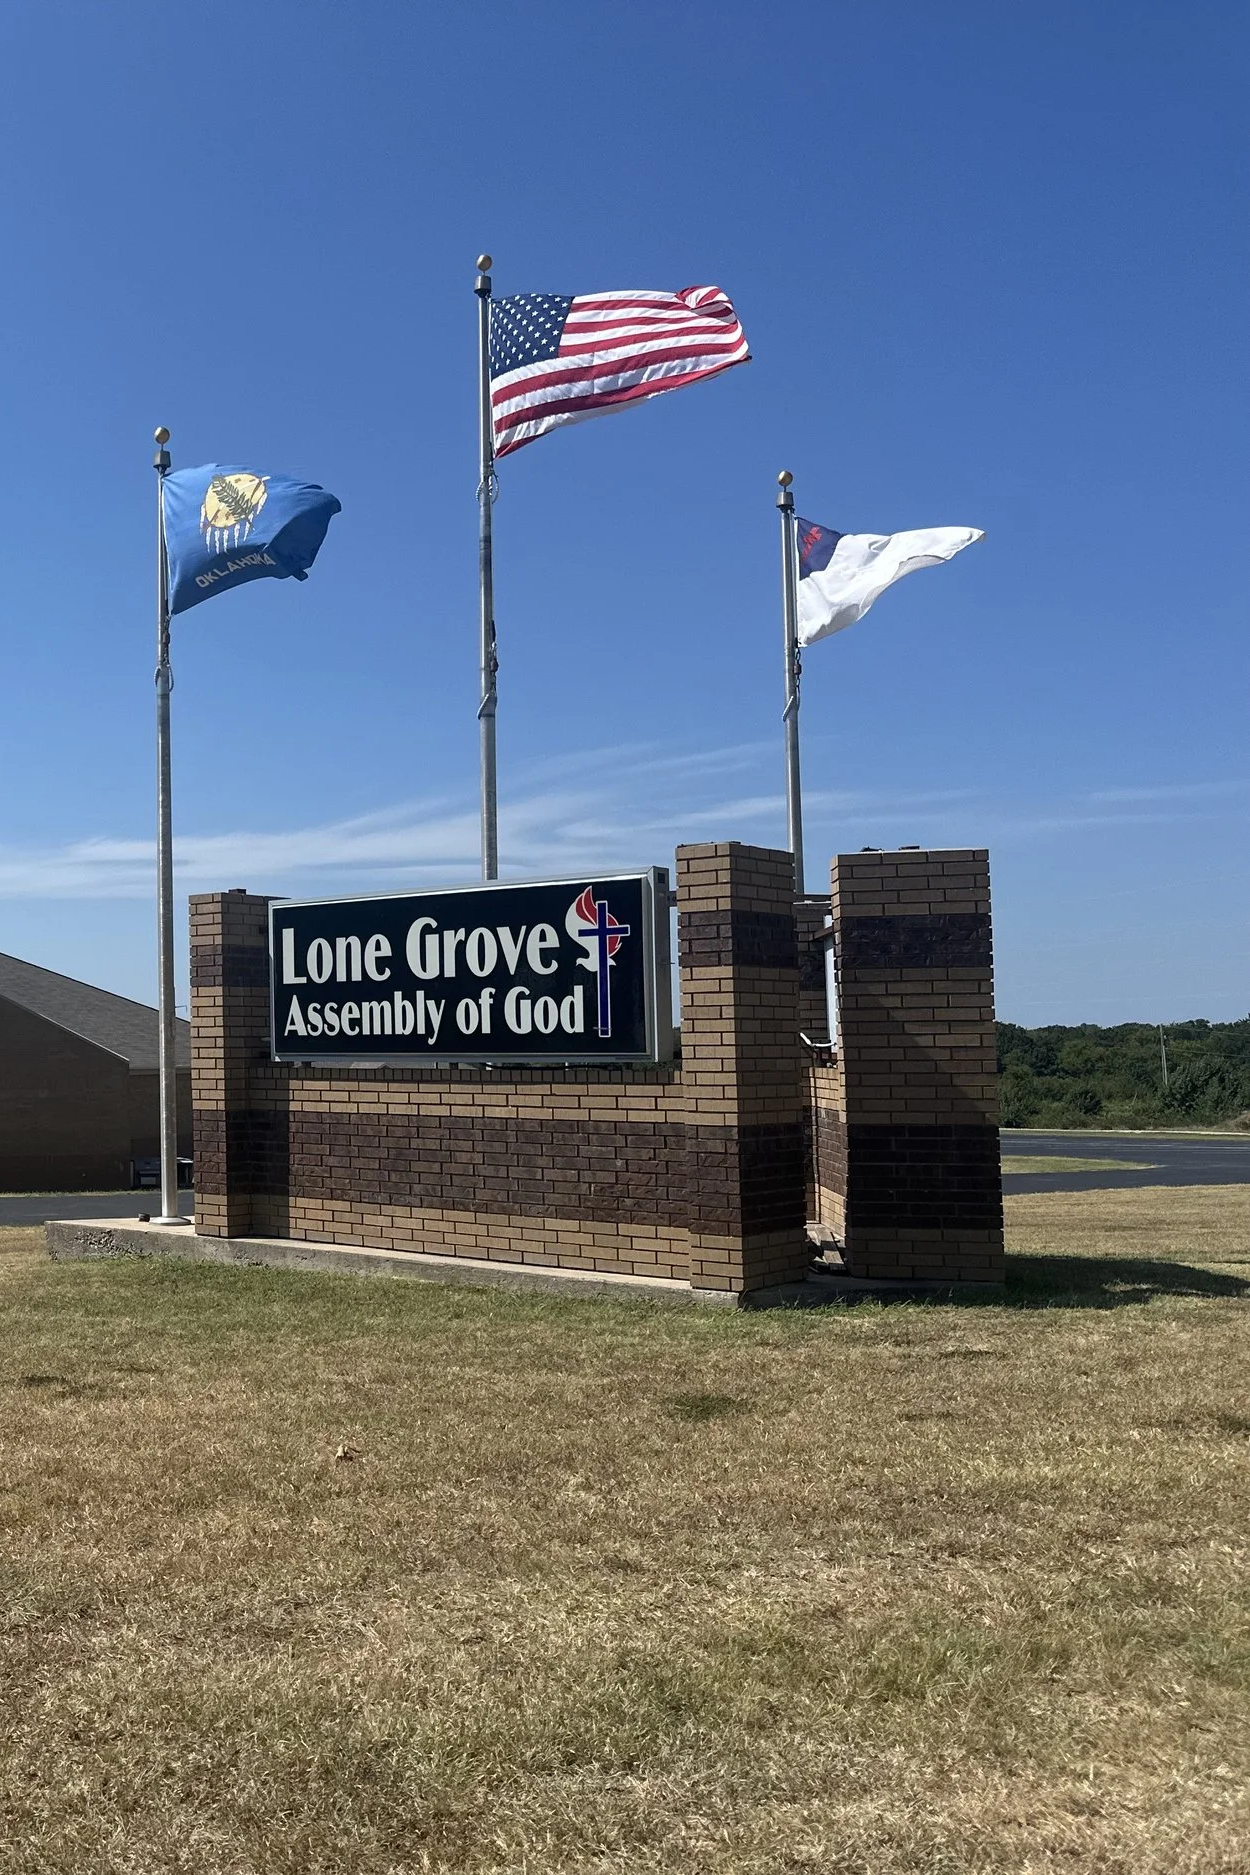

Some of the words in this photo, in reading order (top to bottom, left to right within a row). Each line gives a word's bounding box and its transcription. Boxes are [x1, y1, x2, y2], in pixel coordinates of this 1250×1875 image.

[195, 553, 276, 587] OKLAHOMA
[282, 928, 393, 985] Lone
[406, 916, 560, 980] Grove
[284, 990, 445, 1045] Assembly
[455, 987, 496, 1035] of
[504, 985, 585, 1035] God
